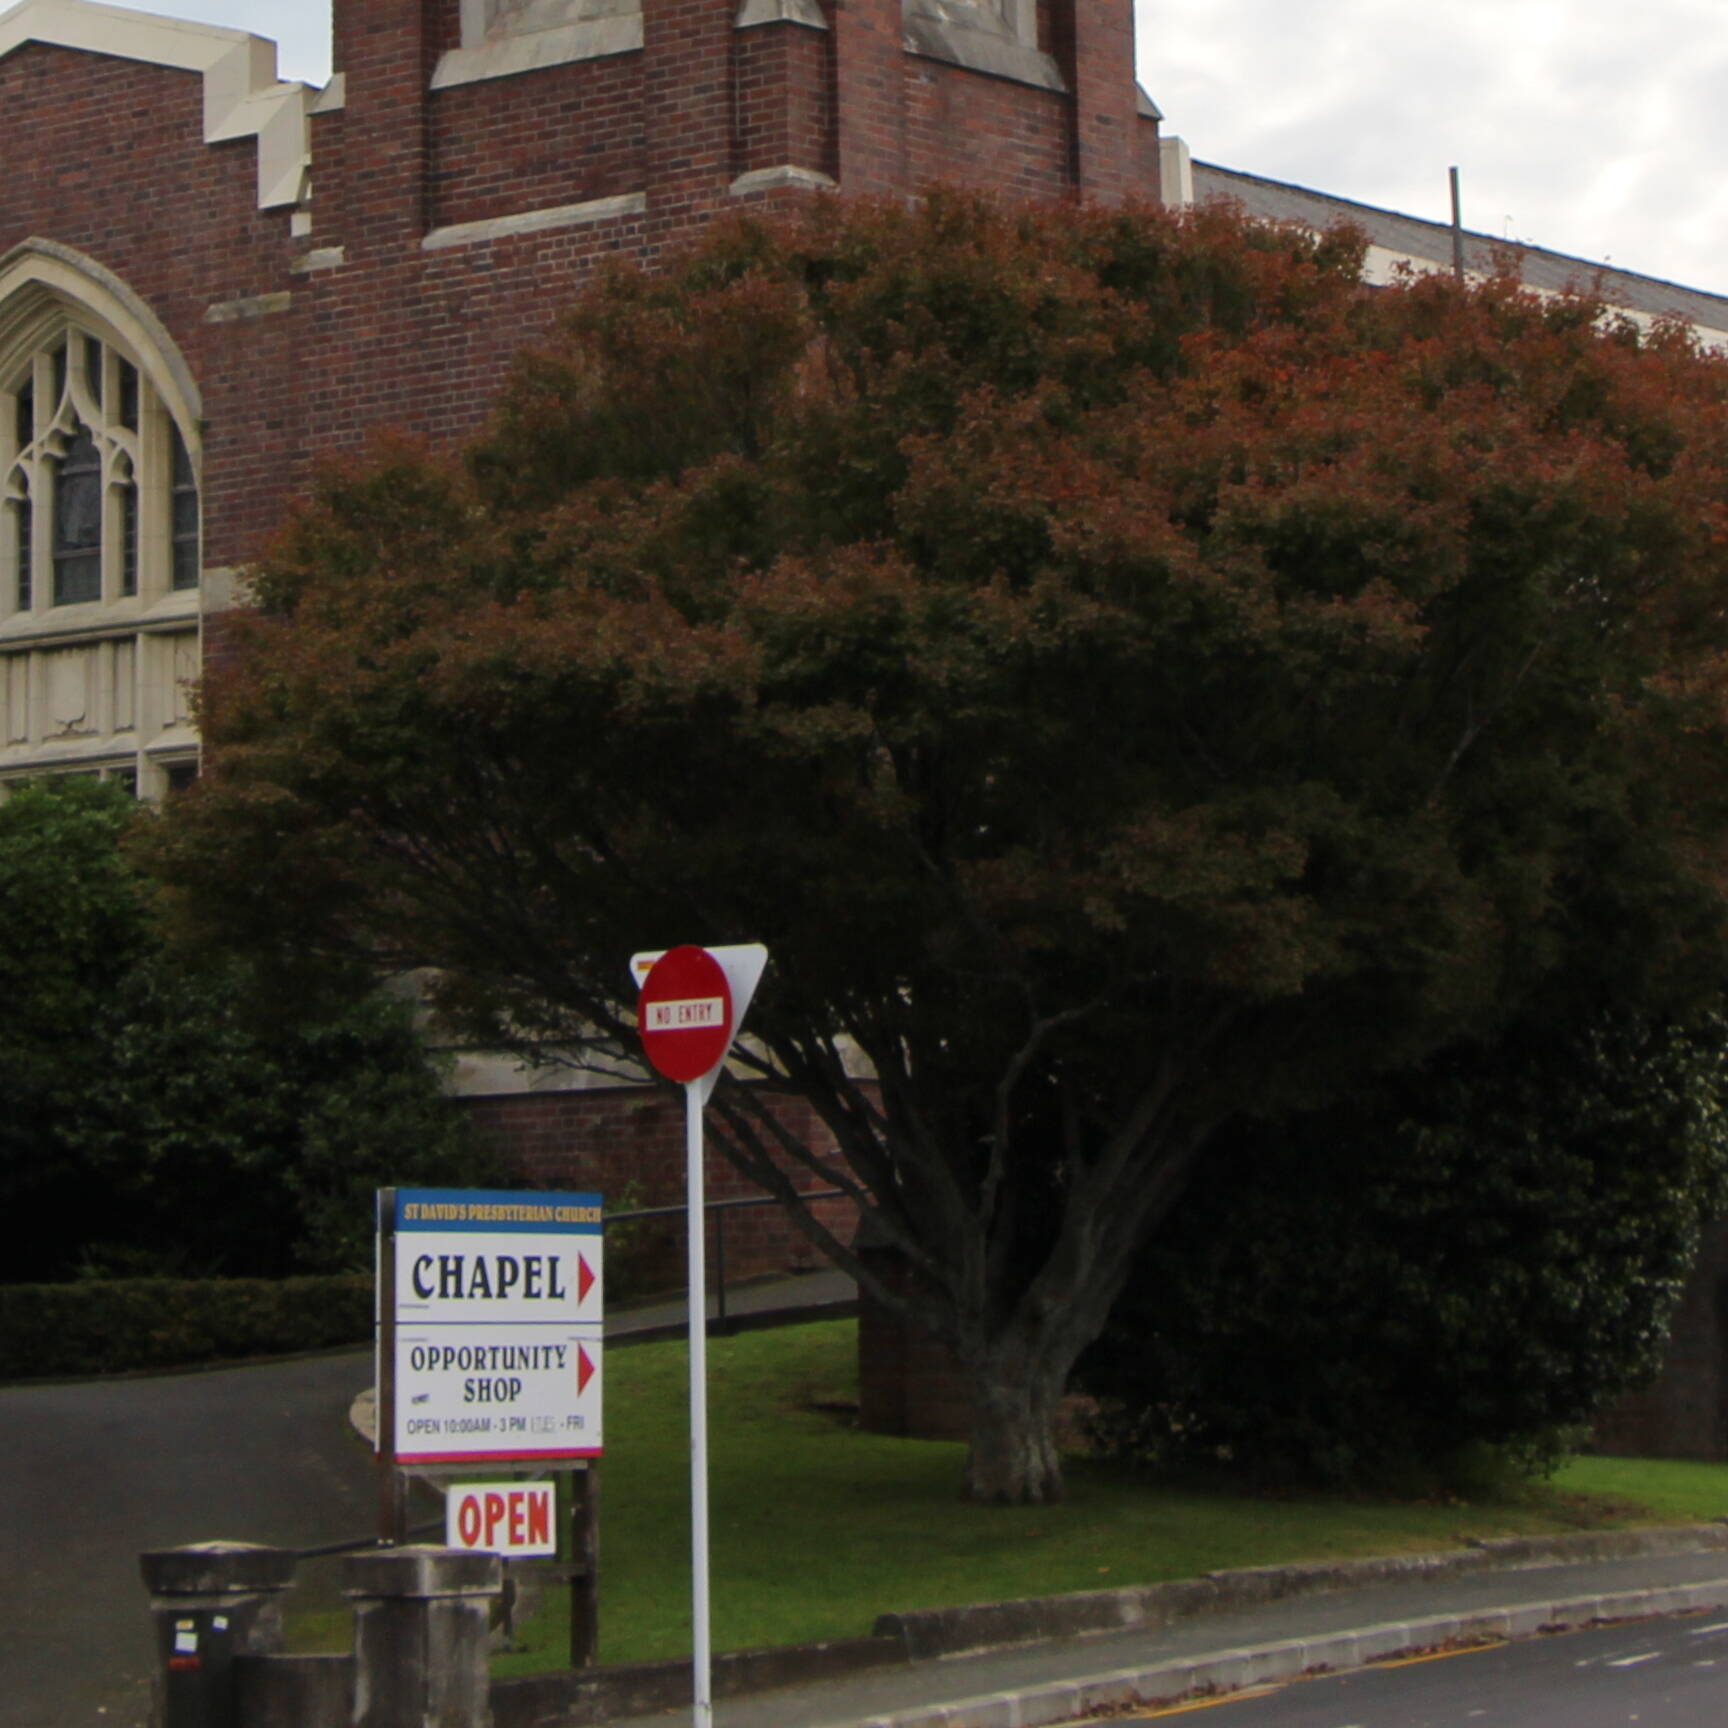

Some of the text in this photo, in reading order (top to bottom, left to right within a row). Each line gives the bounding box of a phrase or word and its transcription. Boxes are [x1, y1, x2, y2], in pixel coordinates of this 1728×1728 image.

[656, 1003, 713, 1025] NO ENTRY
[404, 1203, 602, 1223] ST DAVID'S PRESBYTERIAN CHURCH
[412, 1254, 566, 1300] CHAPEL
[411, 1345, 568, 1371] OPPORTUNITY
[464, 1377, 522, 1403] SHOP
[407, 1418, 440, 1435] OPEN
[444, 1417, 491, 1434] 10:00AM
[500, 1418, 507, 1433] 3
[509, 1416, 527, 1432] PM
[566, 1415, 585, 1431] FRI
[458, 1491, 549, 1547] OPEN
